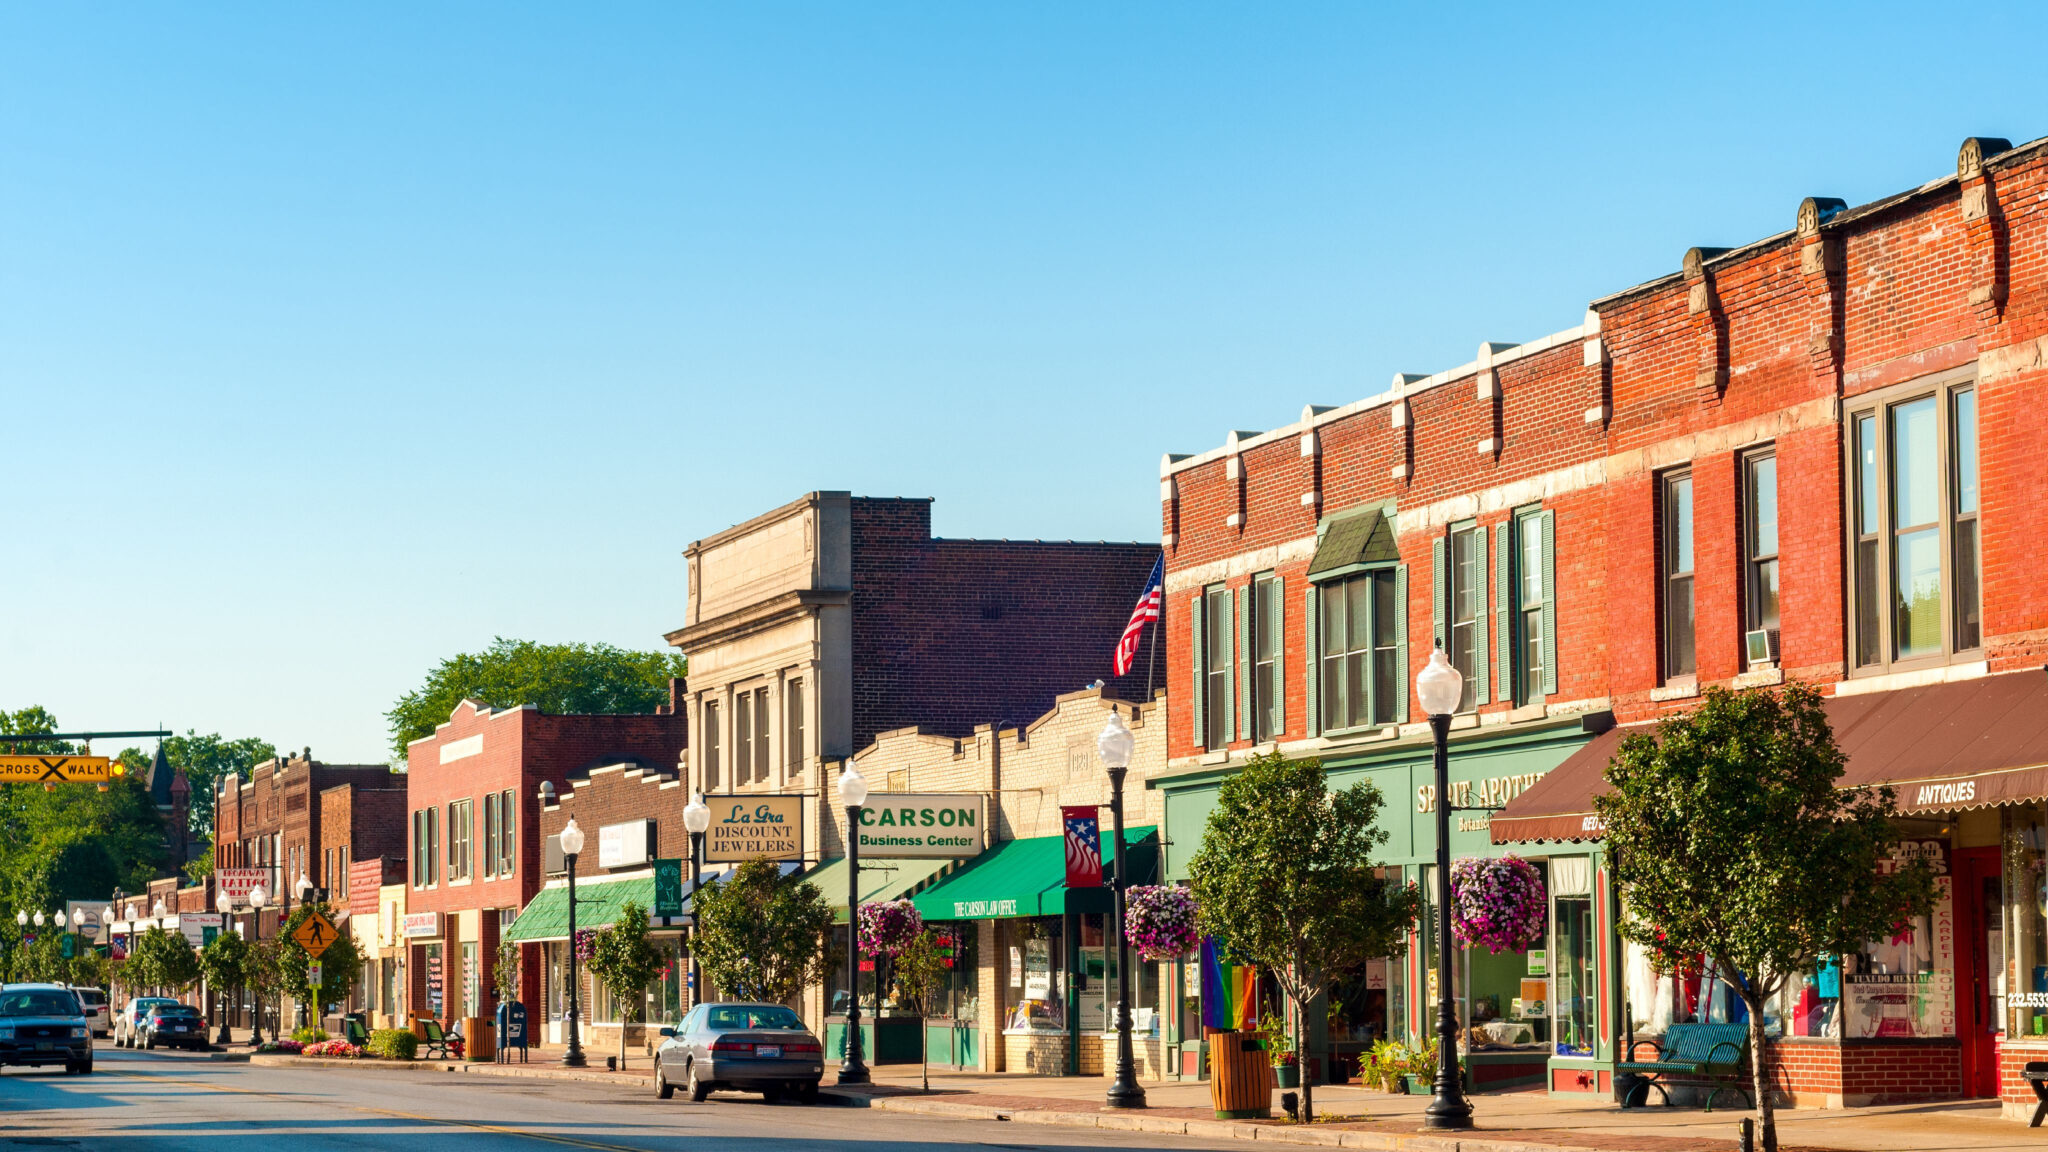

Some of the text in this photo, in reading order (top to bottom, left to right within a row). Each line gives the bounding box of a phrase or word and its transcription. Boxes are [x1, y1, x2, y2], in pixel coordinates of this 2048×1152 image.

[1960, 146, 1981, 175] 94
[67, 765, 103, 775] WALK
[1417, 772, 1546, 813] SPIT APOTH
[1917, 781, 1976, 805] ANTIQUES
[722, 804, 784, 824] La Gra
[859, 807, 975, 827] CARSON
[715, 825, 793, 838] DISCOUNT
[1582, 817, 1598, 831] RED
[712, 840, 795, 853] JEWELERS
[859, 834, 974, 846] Business Center
[223, 869, 265, 877] BROADWAY
[219, 878, 270, 888] TATTOO
[953, 899, 1017, 917] THE CARSON LAW OFFICE
[1938, 911, 1952, 959] CARPET
[1853, 974, 1891, 983] TUXEDO
[1940, 969, 1954, 1034] BOUTIQUE
[2008, 992, 2048, 1008] 232.5533
